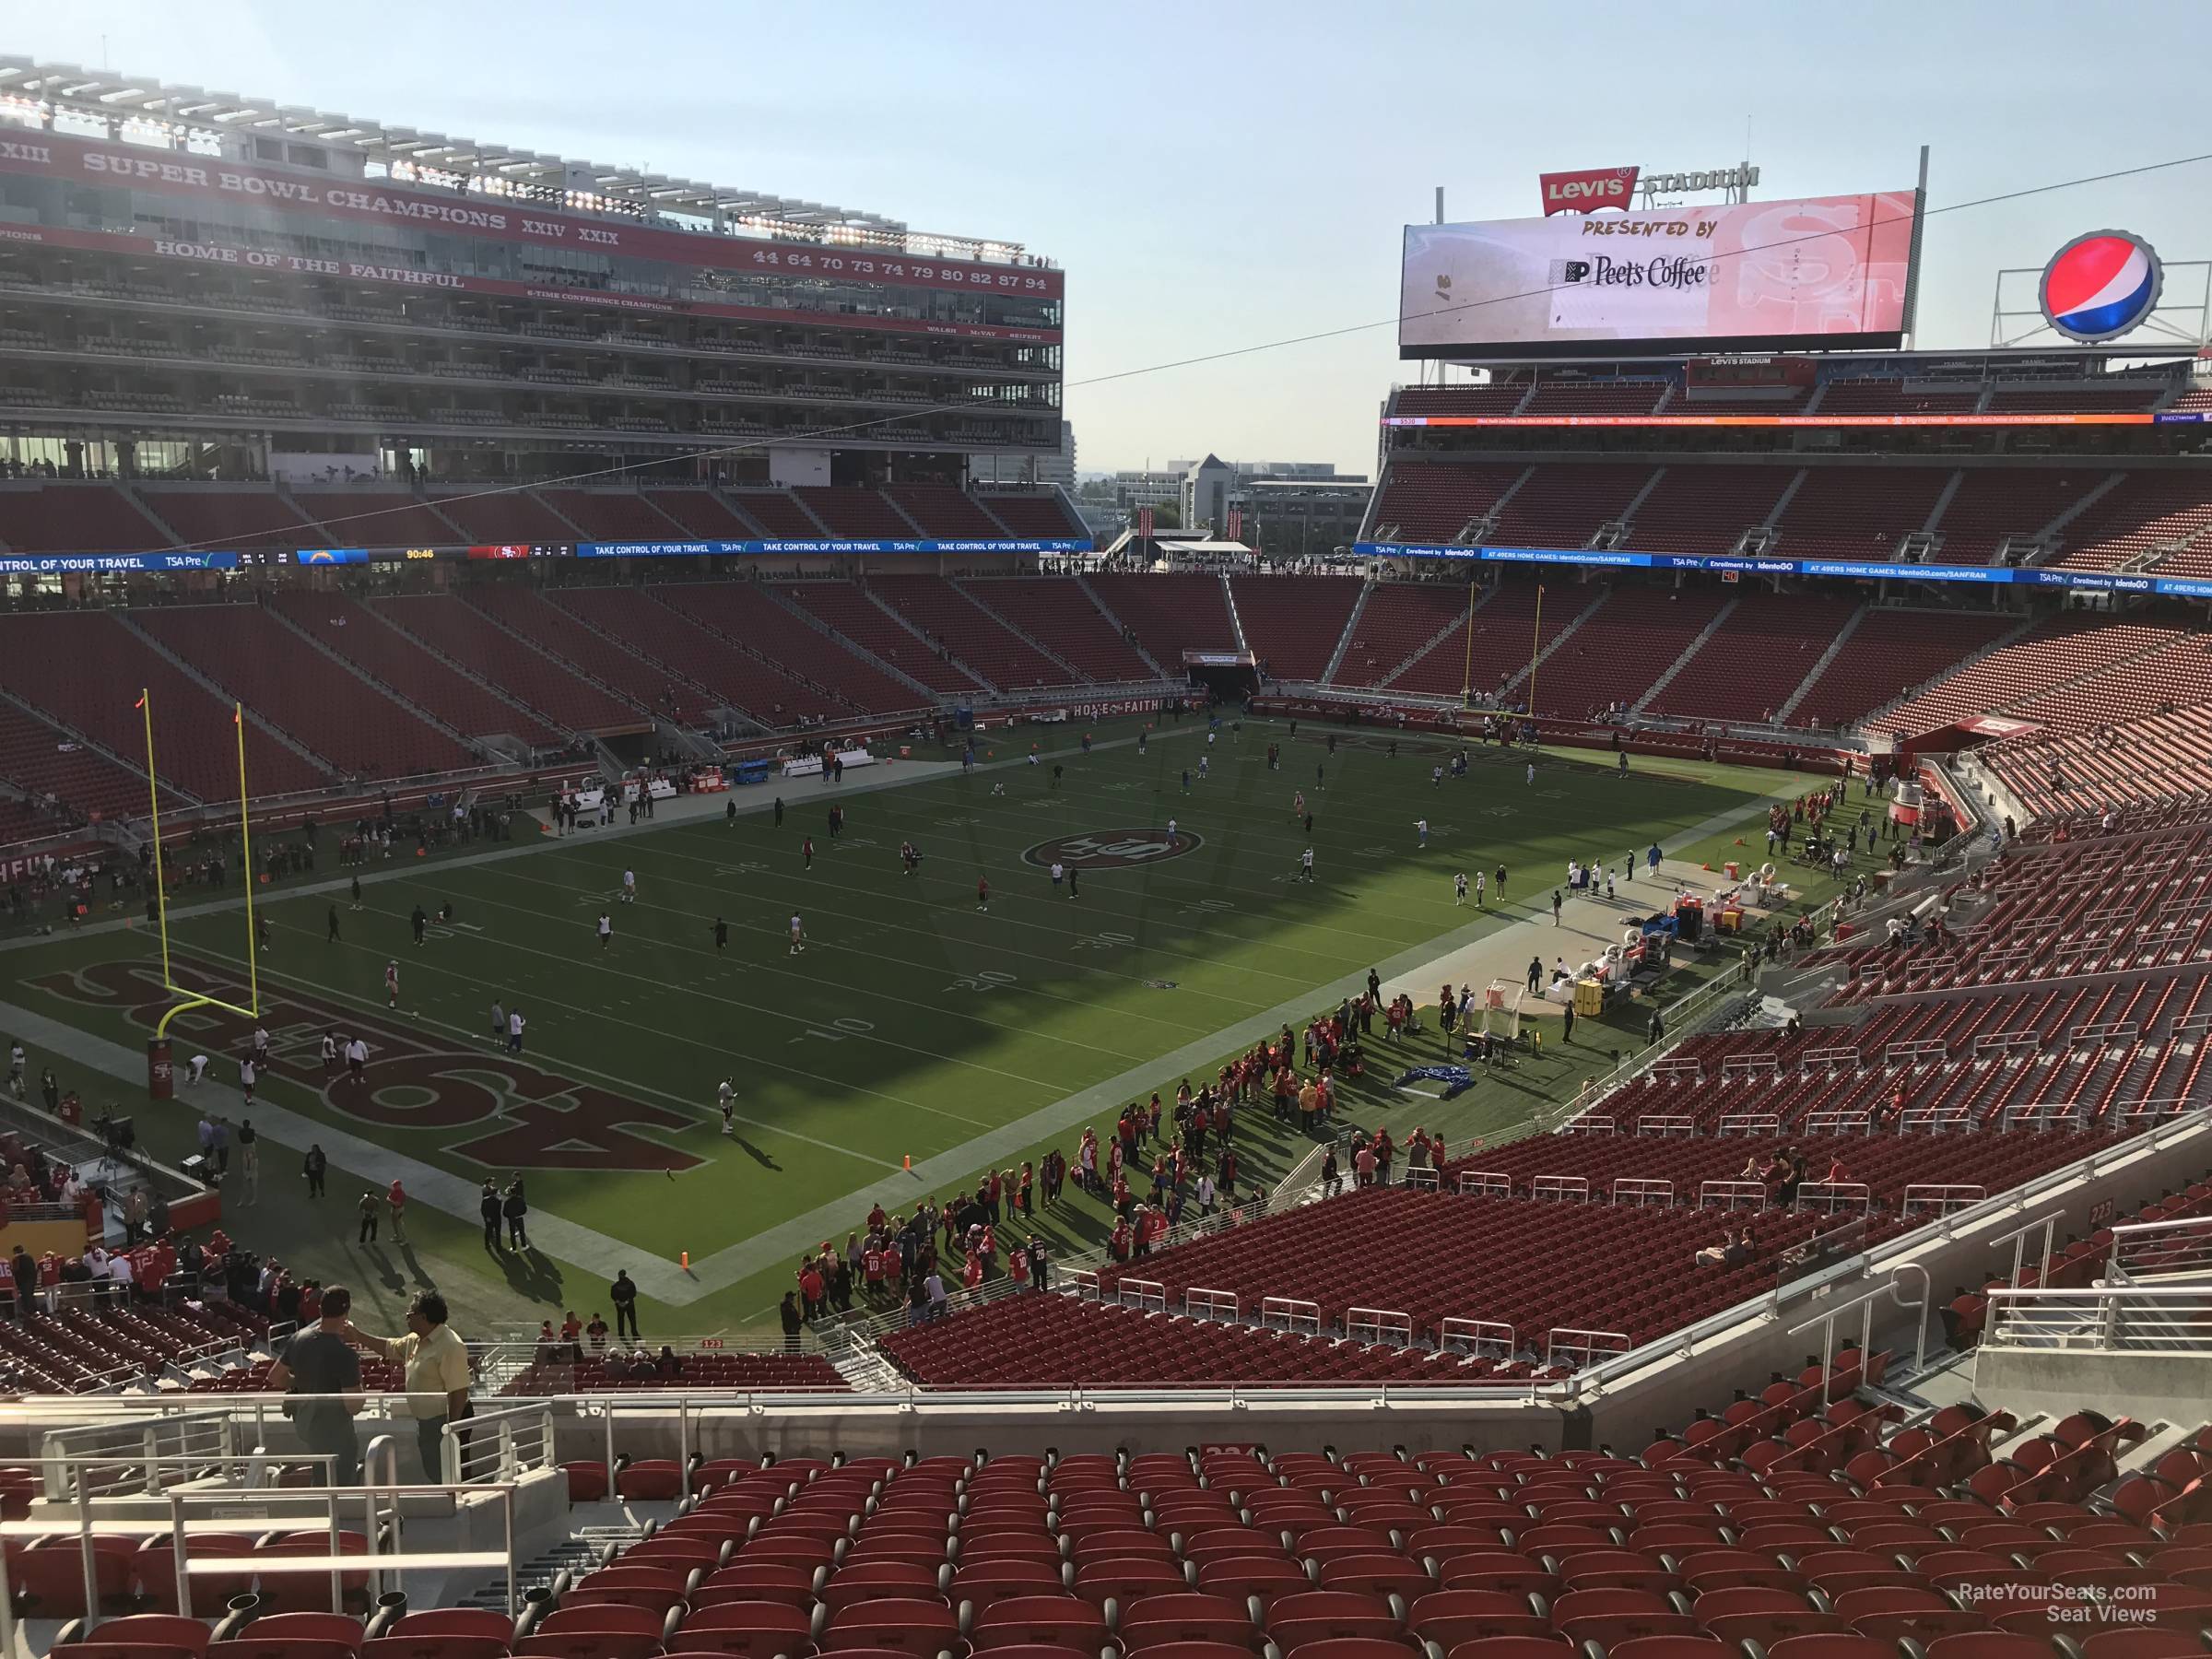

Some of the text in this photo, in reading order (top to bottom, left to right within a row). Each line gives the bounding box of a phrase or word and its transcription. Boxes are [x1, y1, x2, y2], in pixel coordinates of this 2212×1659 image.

[1643, 166, 1759, 194] STADIUM
[83, 153, 619, 245] SUPER BOWL CHAMPIONS XXIV XXIX
[1582, 219, 1717, 240] PRESENTED BY
[155, 240, 465, 288] HOME OF THE FAITHFUL
[752, 250, 1047, 290] 44 64 70 73 74 79 80 82 87 94
[1594, 256, 1644, 286] Peet's
[1648, 256, 1705, 289] Coffee
[561, 293, 619, 305] CONFERENCE
[621, 300, 673, 311] CHAMPIONS
[927, 325, 957, 334] WALSH
[594, 544, 709, 555] TAKE CONTROL OF YOUR TRAVEL
[762, 543, 782, 551] TAKE
[783, 543, 818, 551] CONTROL
[893, 542, 915, 550] TSA Pre
[956, 542, 986, 550] CONTROL
[987, 542, 996, 550] OF
[997, 542, 1016, 550] YOUR
[41, 559, 57, 570] OF
[59, 559, 95, 570] YOUR
[98, 558, 144, 569] TRAVEL
[165, 556, 201, 567] TSA Pre
[1672, 558, 1753, 570] TSA Pre Enrollment by
[1821, 565, 1844, 573] 49ERS
[1846, 566, 1867, 574] HOME
[1724, 571, 1736, 581] 40
[2040, 573, 2112, 588] TSA Pre Enrollment by
[2163, 582, 2172, 591] AT
[2173, 583, 2195, 593] 49ERS
[1124, 699, 1176, 713] FAITHU
[953, 970, 1018, 994] 20
[868, 1259, 879, 1272] 10
[1018, 1255, 1027, 1268] 10
[703, 1340, 723, 1348] 123
